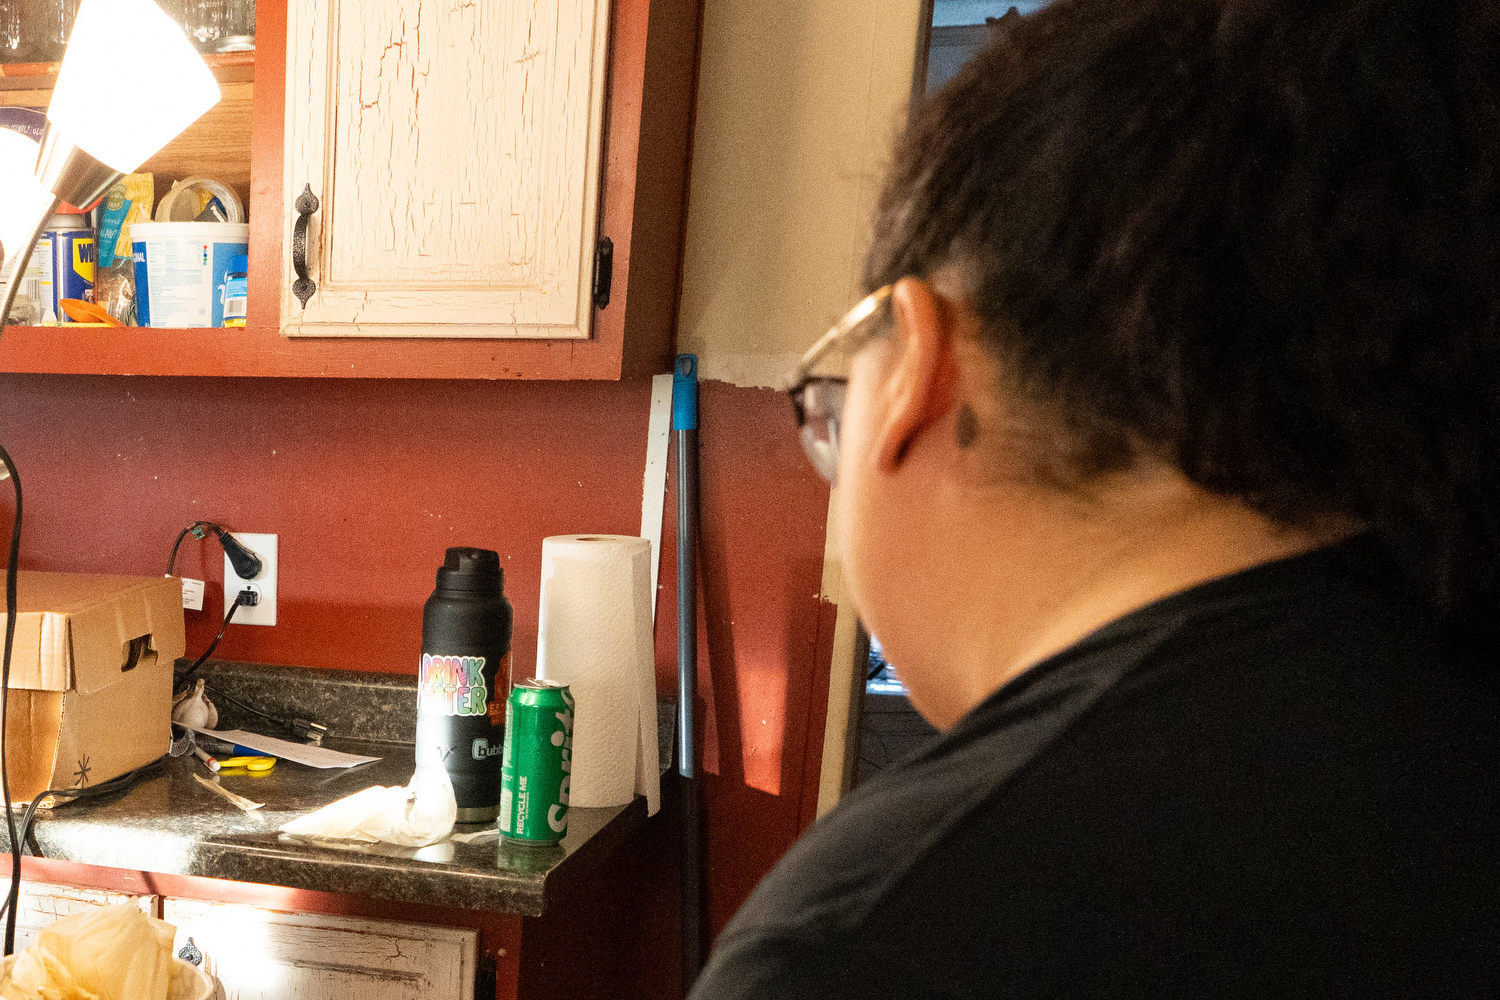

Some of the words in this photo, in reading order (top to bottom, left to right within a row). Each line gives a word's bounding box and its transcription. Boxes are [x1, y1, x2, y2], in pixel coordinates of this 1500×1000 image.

[423, 656, 485, 686] DRINK
[519, 775, 528, 791] ME
[516, 791, 526, 835] RECYCLE
